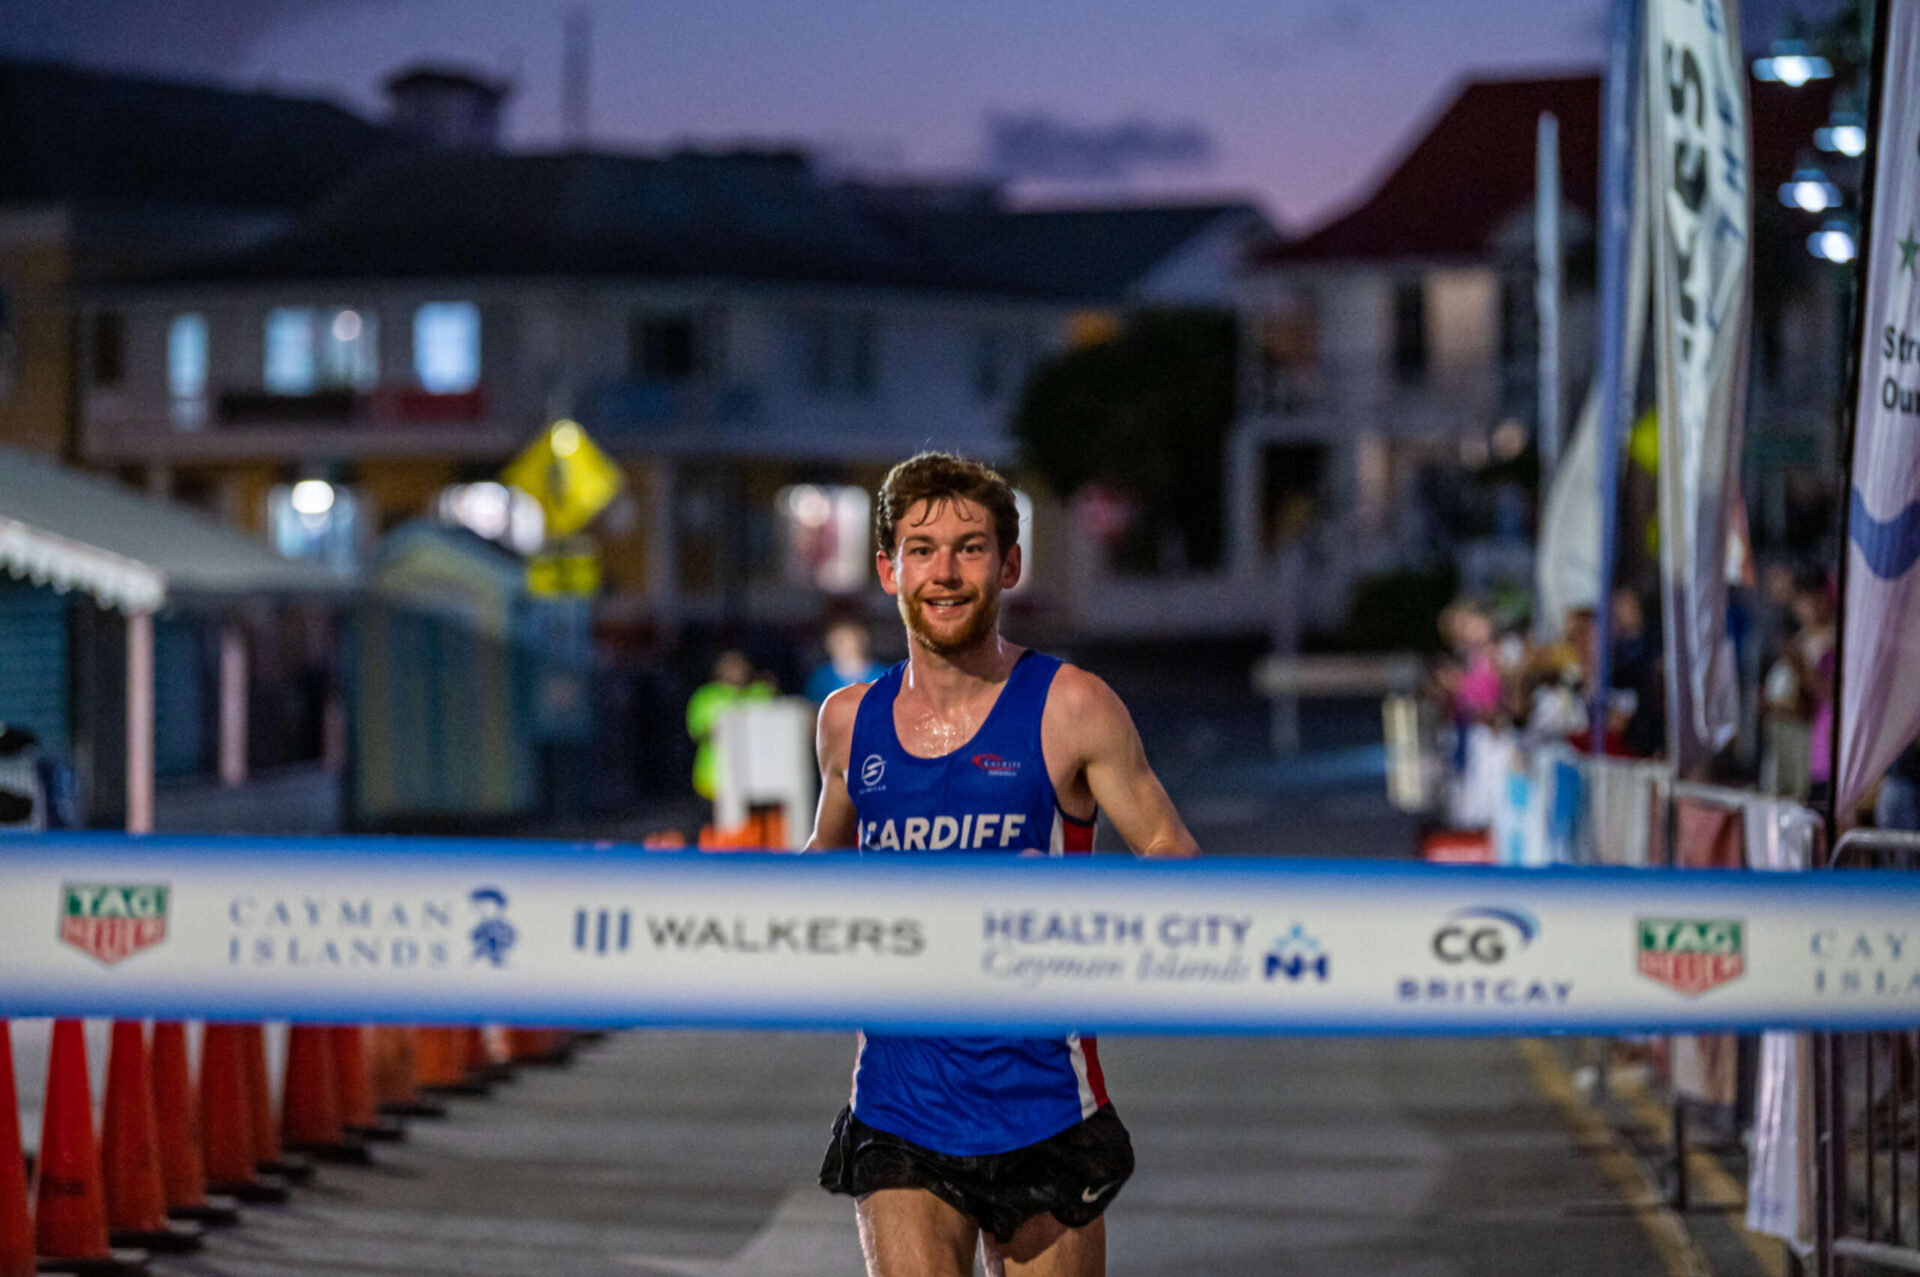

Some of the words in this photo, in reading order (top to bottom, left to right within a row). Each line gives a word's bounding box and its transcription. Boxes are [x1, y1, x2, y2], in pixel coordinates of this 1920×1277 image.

[1883, 325, 1920, 363] Str
[69, 885, 158, 917] TAG
[228, 898, 452, 928] CAYMAN
[645, 915, 926, 957] WALKERS
[982, 911, 1145, 945] HEALTH
[1157, 913, 1254, 949] CITY
[1431, 925, 1507, 965] CG
[1646, 920, 1733, 954] TAG
[228, 936, 449, 968] ISLANDS
[1398, 977, 1573, 1002] BRITCAY
